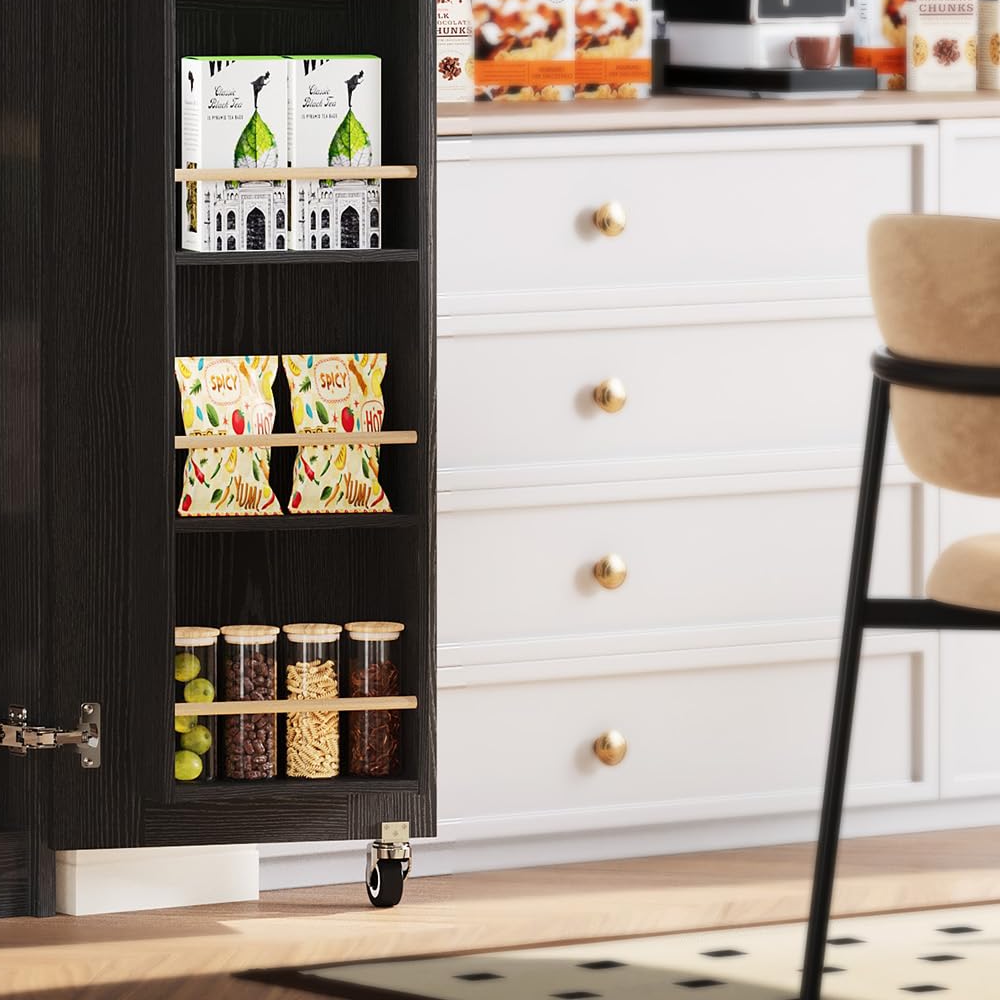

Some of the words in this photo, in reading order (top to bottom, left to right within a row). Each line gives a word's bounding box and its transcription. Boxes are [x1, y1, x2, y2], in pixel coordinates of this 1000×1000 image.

[919, 3, 974, 12] CHUNKS
[207, 98, 229, 109] Black
[230, 98, 243, 109] Tea
[302, 96, 323, 108] Black
[324, 96, 337, 108] Tea
